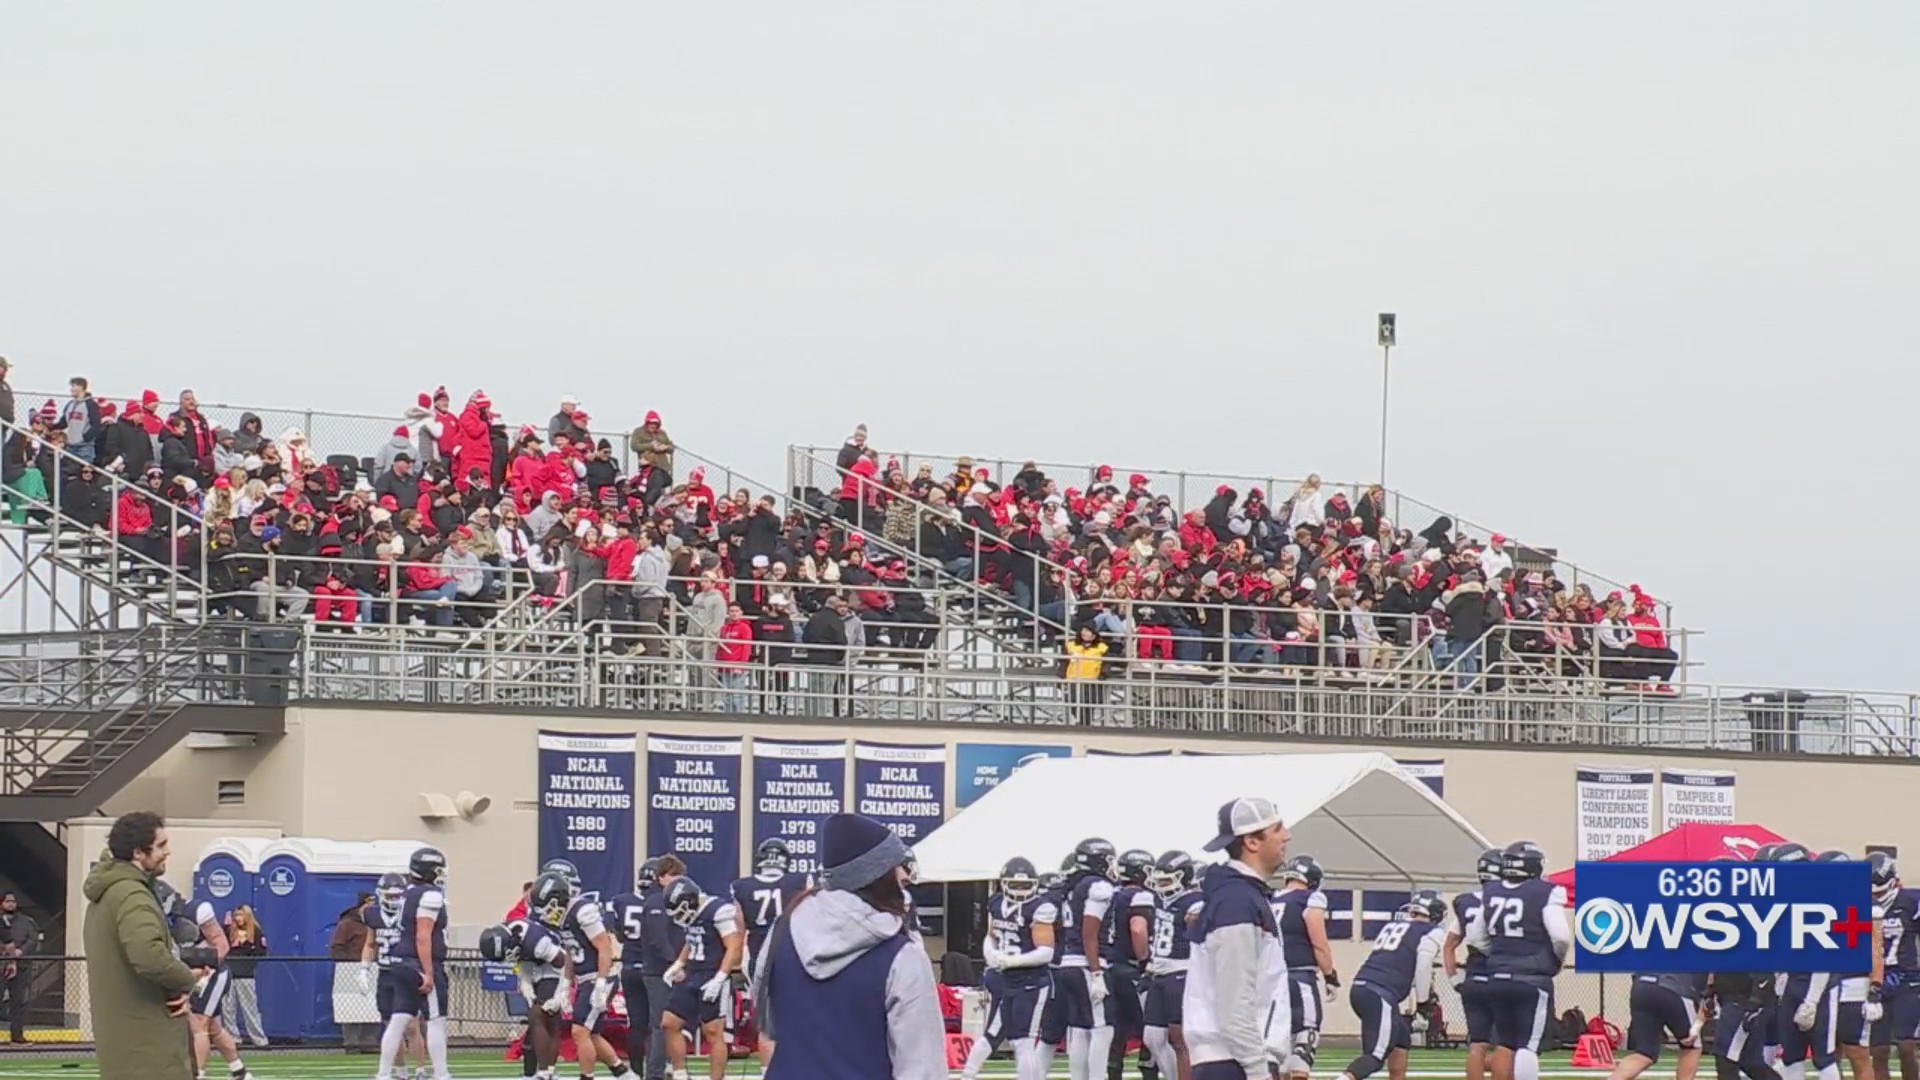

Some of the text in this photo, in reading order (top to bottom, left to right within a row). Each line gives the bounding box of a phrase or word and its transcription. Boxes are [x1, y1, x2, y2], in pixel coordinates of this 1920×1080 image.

[567, 741, 608, 749] BASEBALL
[780, 748, 819, 756] FOOTBALL
[567, 757, 608, 773] NCAA
[675, 760, 715, 775] NCAA
[780, 764, 818, 779] NCAA
[880, 767, 918, 782] NCAA
[1598, 773, 1632, 783] FOOTBALL
[1683, 775, 1717, 785] FOOTBALL
[550, 774, 624, 791] NATIONAL
[659, 777, 729, 793] NATIONAL
[765, 781, 833, 797] NATIONAL
[866, 783, 934, 799] NATIONAL
[1582, 787, 1649, 801] LIBERTY LEAGUE
[1676, 790, 1716, 803] EMPIRE
[545, 792, 631, 809] CHAMPIONS
[652, 794, 736, 811] CHAMPIONS
[759, 798, 840, 814] CHAMPIONS
[1582, 801, 1648, 815] CONFERENCE
[860, 800, 940, 817] CHAMPIONS
[1668, 804, 1733, 817] CONFERENCE
[567, 816, 606, 831] 1980
[675, 818, 713, 833] 2004
[780, 820, 816, 835] 1979
[1583, 815, 1649, 829] CHAMPIONS
[567, 836, 606, 851] 1988
[675, 837, 713, 852] 2005
[1586, 833, 1611, 845] 2017
[788, 858, 817, 873] 991
[753, 888, 784, 926] 71
[1488, 896, 1525, 938] 72
[1372, 921, 1411, 952] 68
[1589, 1038, 1613, 1065] 40
